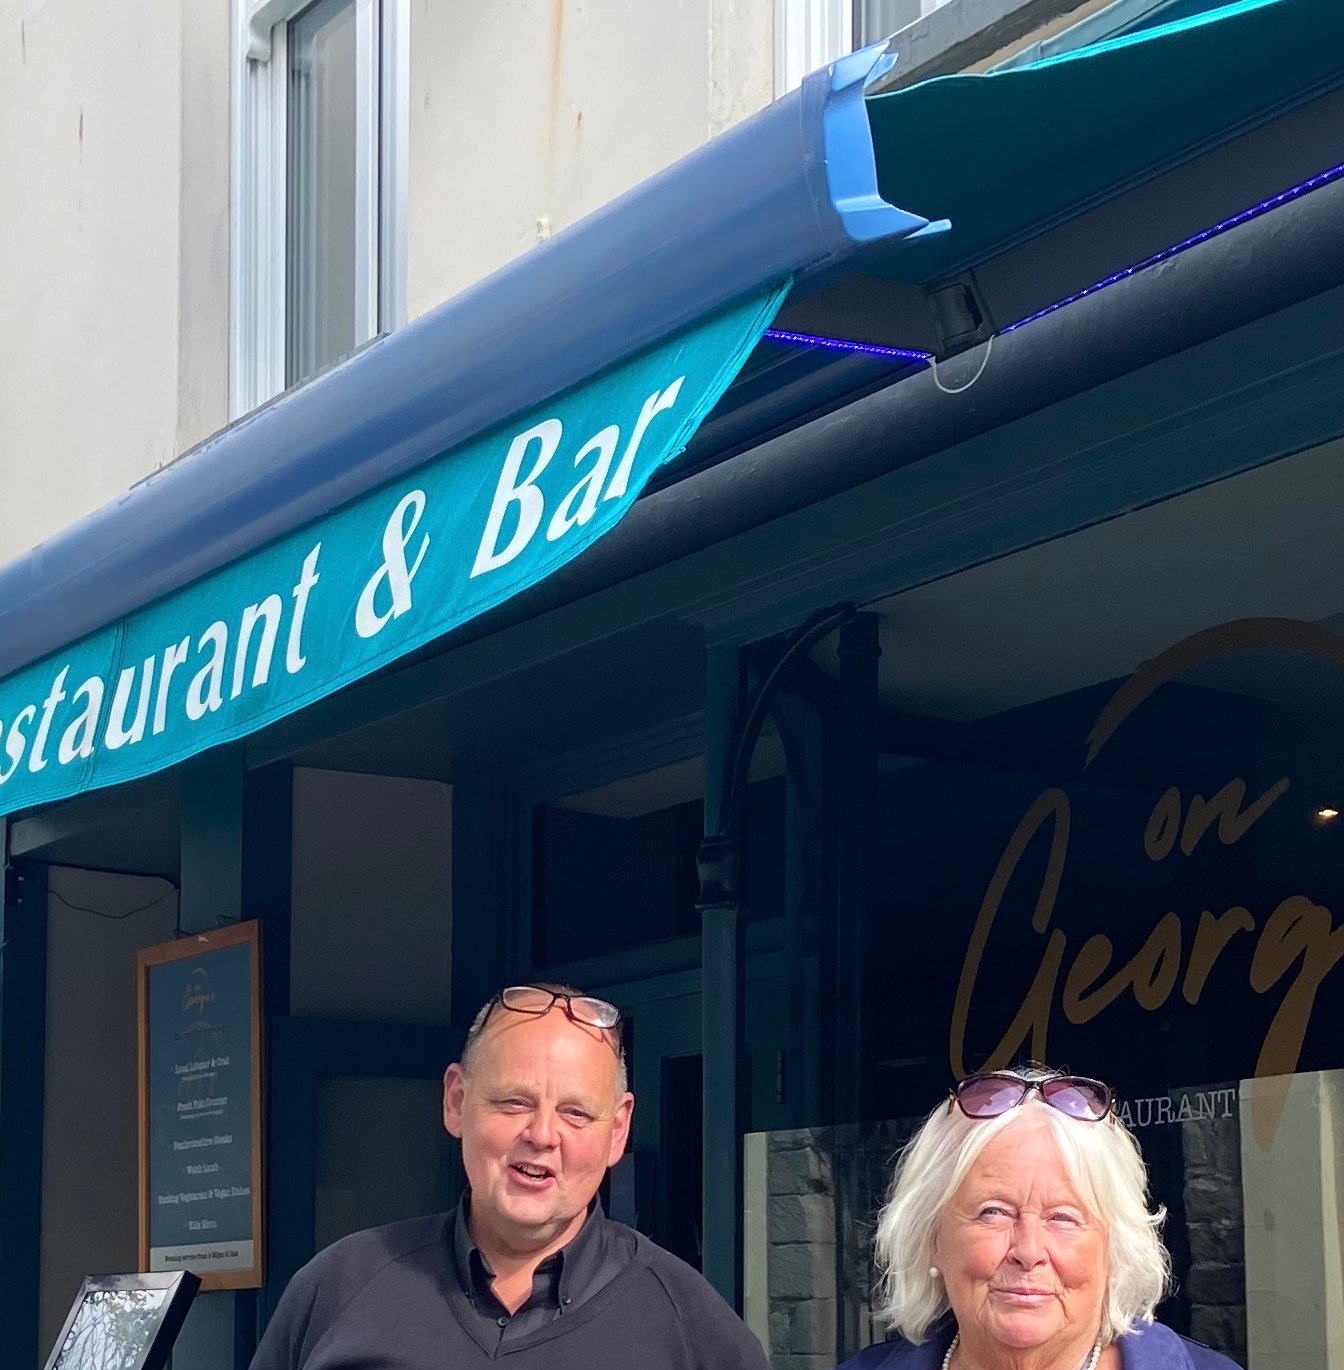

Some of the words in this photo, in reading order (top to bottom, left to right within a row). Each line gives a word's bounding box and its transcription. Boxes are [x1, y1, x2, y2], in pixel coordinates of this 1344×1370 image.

[355, 489, 431, 639] &
[471, 376, 685, 579] Bar
[1145, 777, 1291, 861] on
